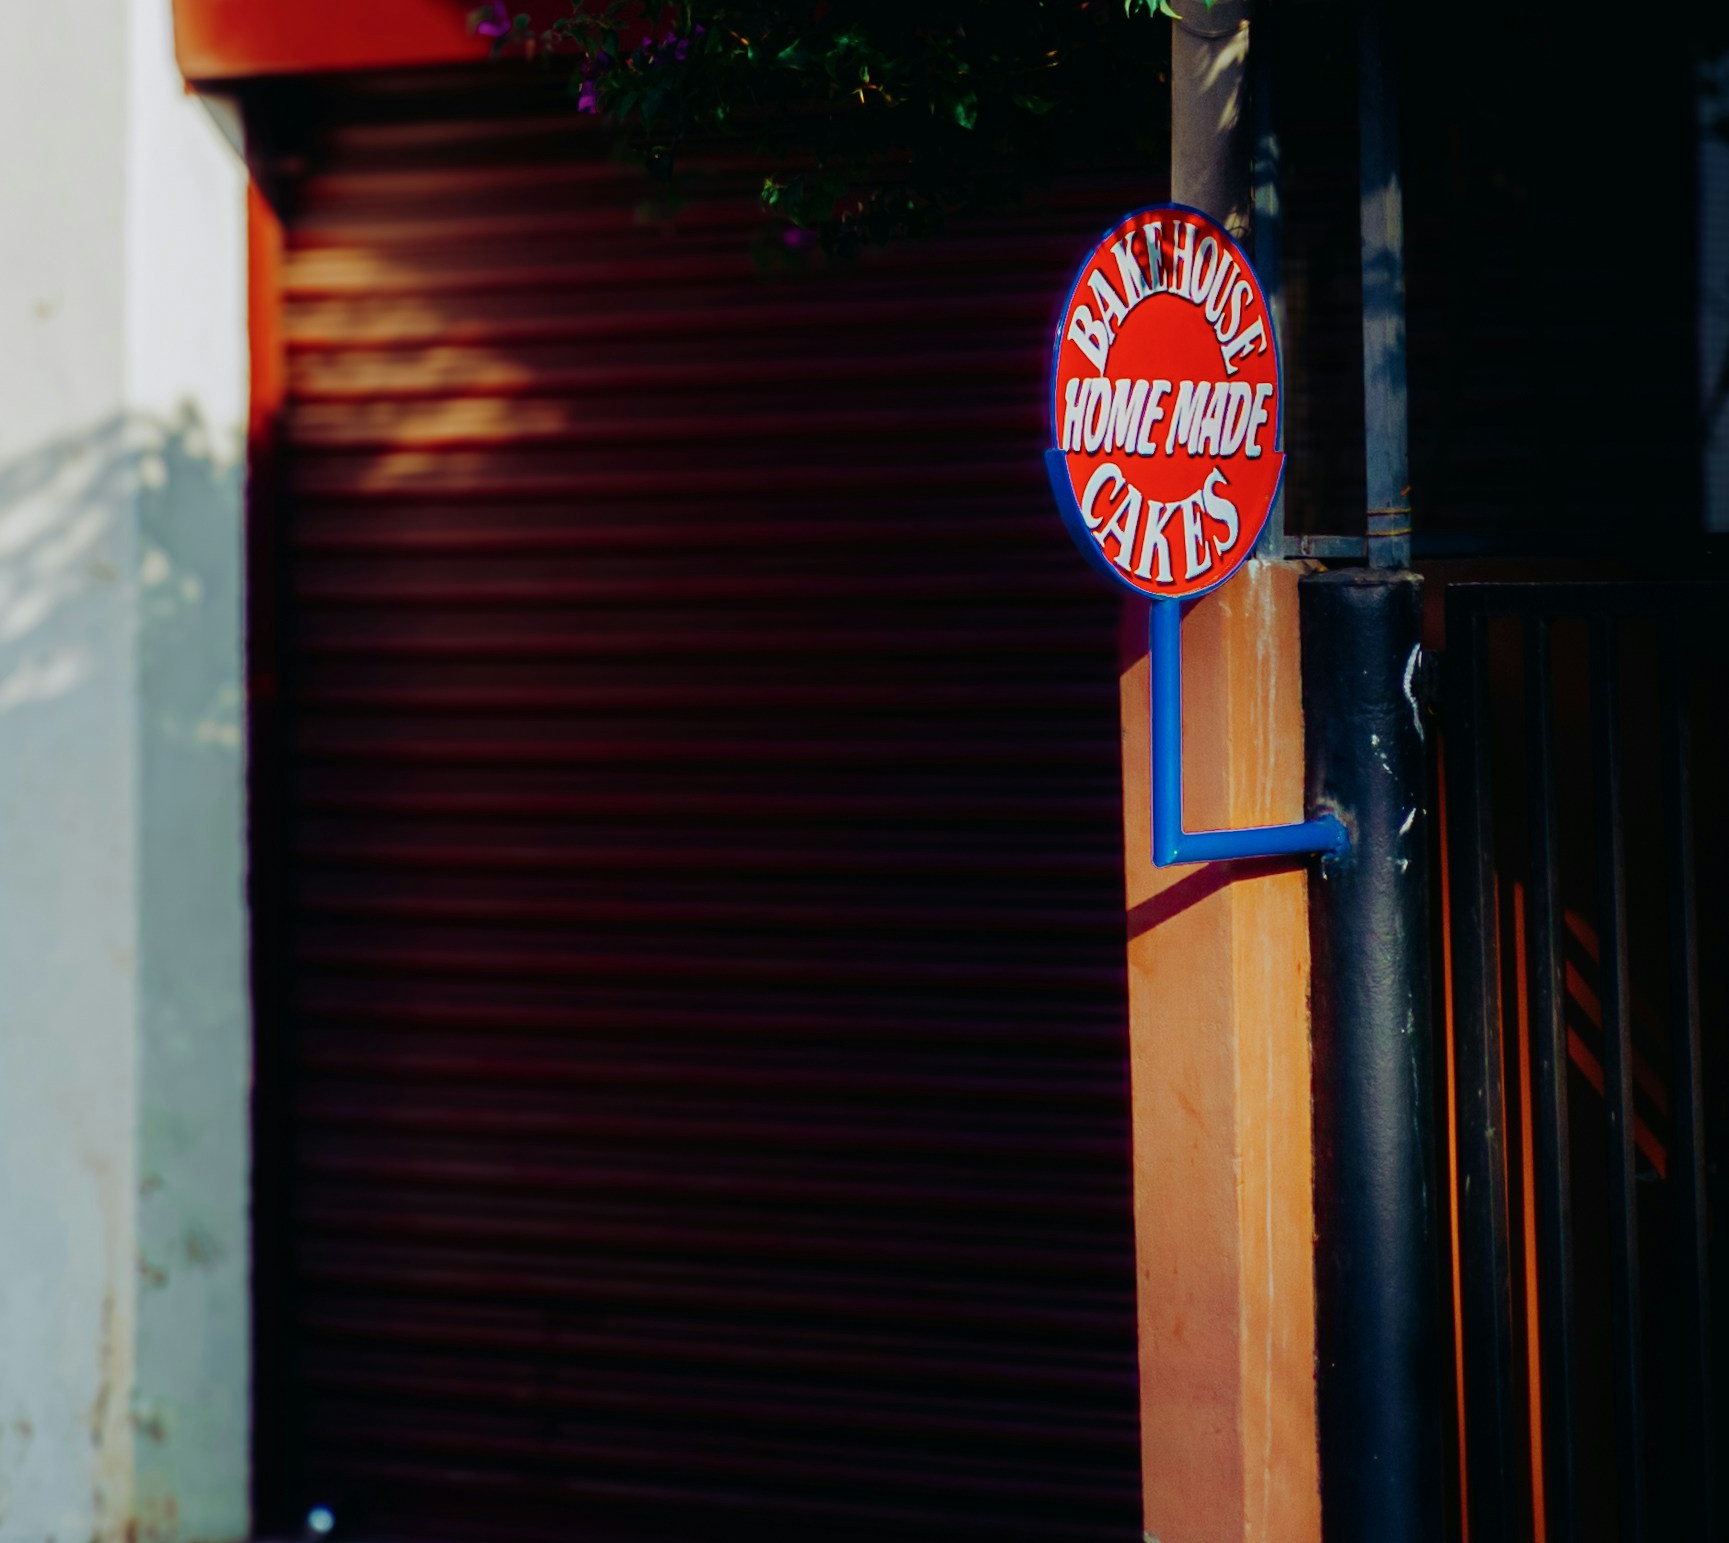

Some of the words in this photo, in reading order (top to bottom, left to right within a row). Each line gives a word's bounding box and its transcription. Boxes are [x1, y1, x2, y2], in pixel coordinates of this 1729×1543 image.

[1062, 378, 1171, 455] HOME
[1165, 381, 1273, 457] MADE
[1081, 462, 1239, 582] CAKES
